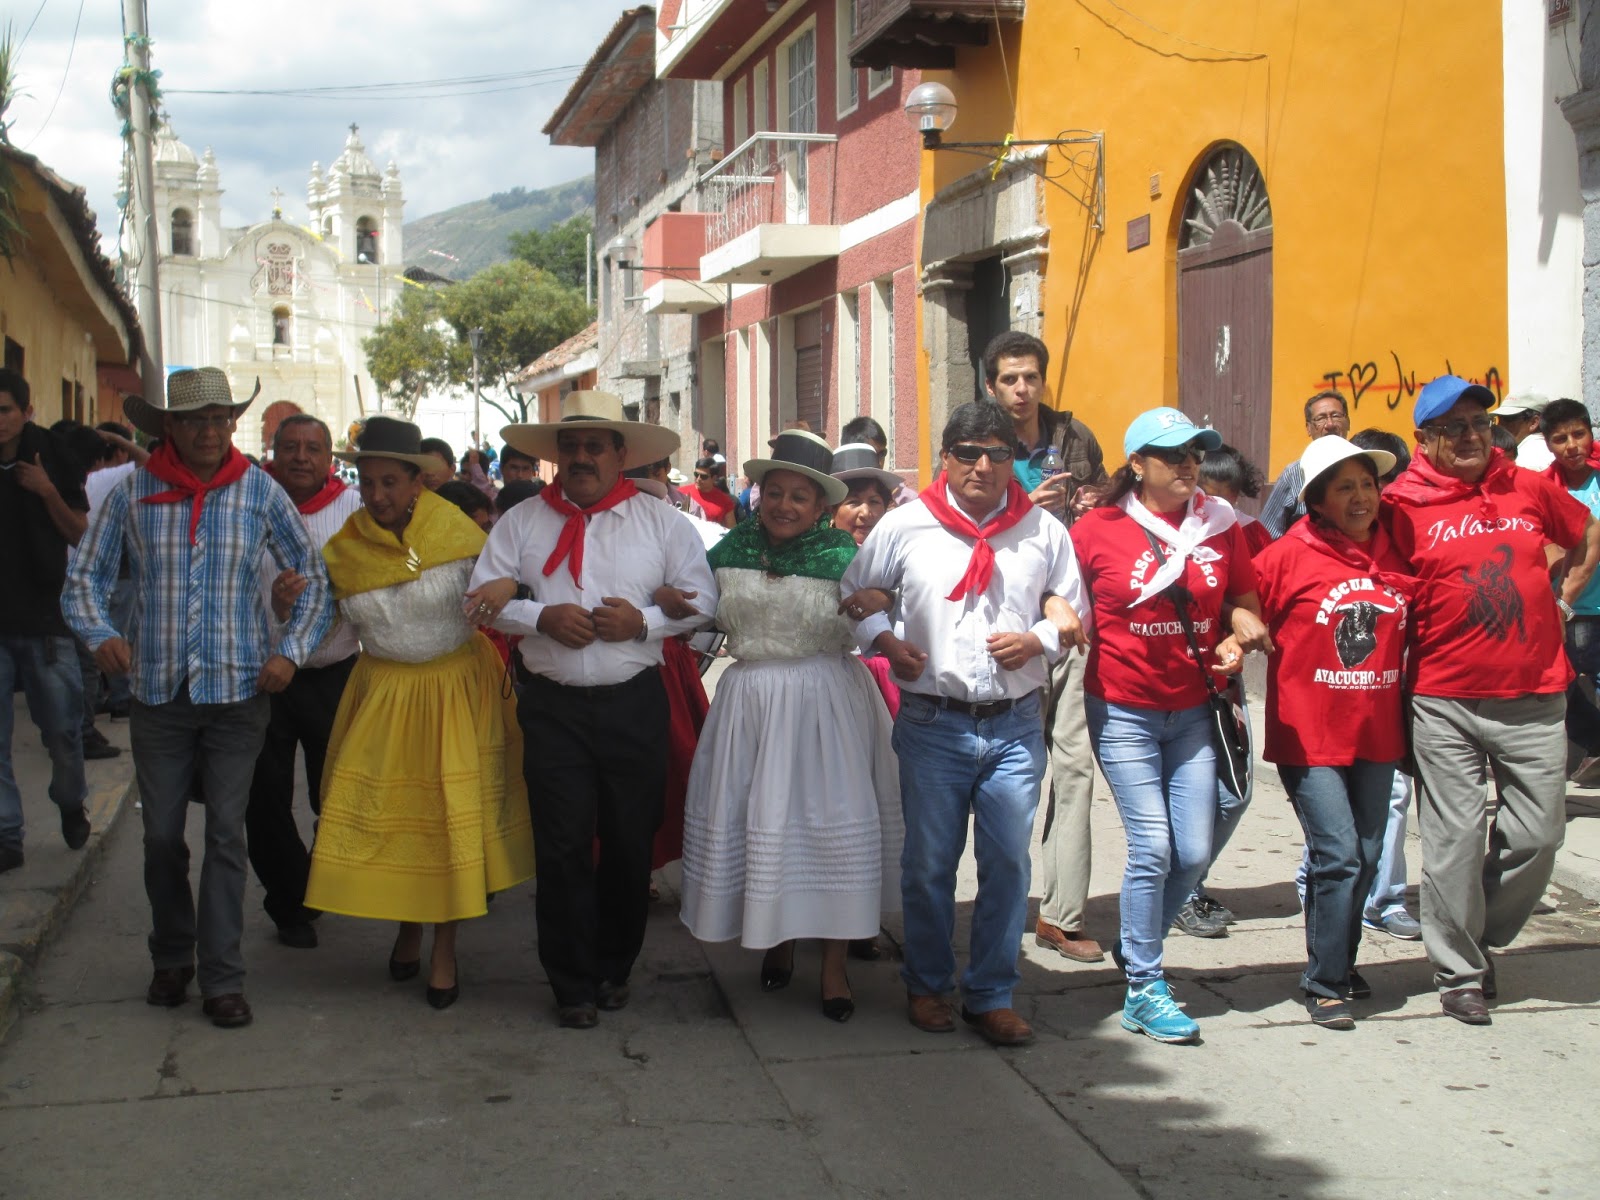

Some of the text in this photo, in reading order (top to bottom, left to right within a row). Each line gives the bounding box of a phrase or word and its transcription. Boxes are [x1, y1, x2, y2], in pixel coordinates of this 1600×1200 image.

[1315, 577, 1375, 626] PASCUA
[1129, 621, 1185, 637] AYACUCH
[1314, 668, 1375, 685] AYACUCHO
